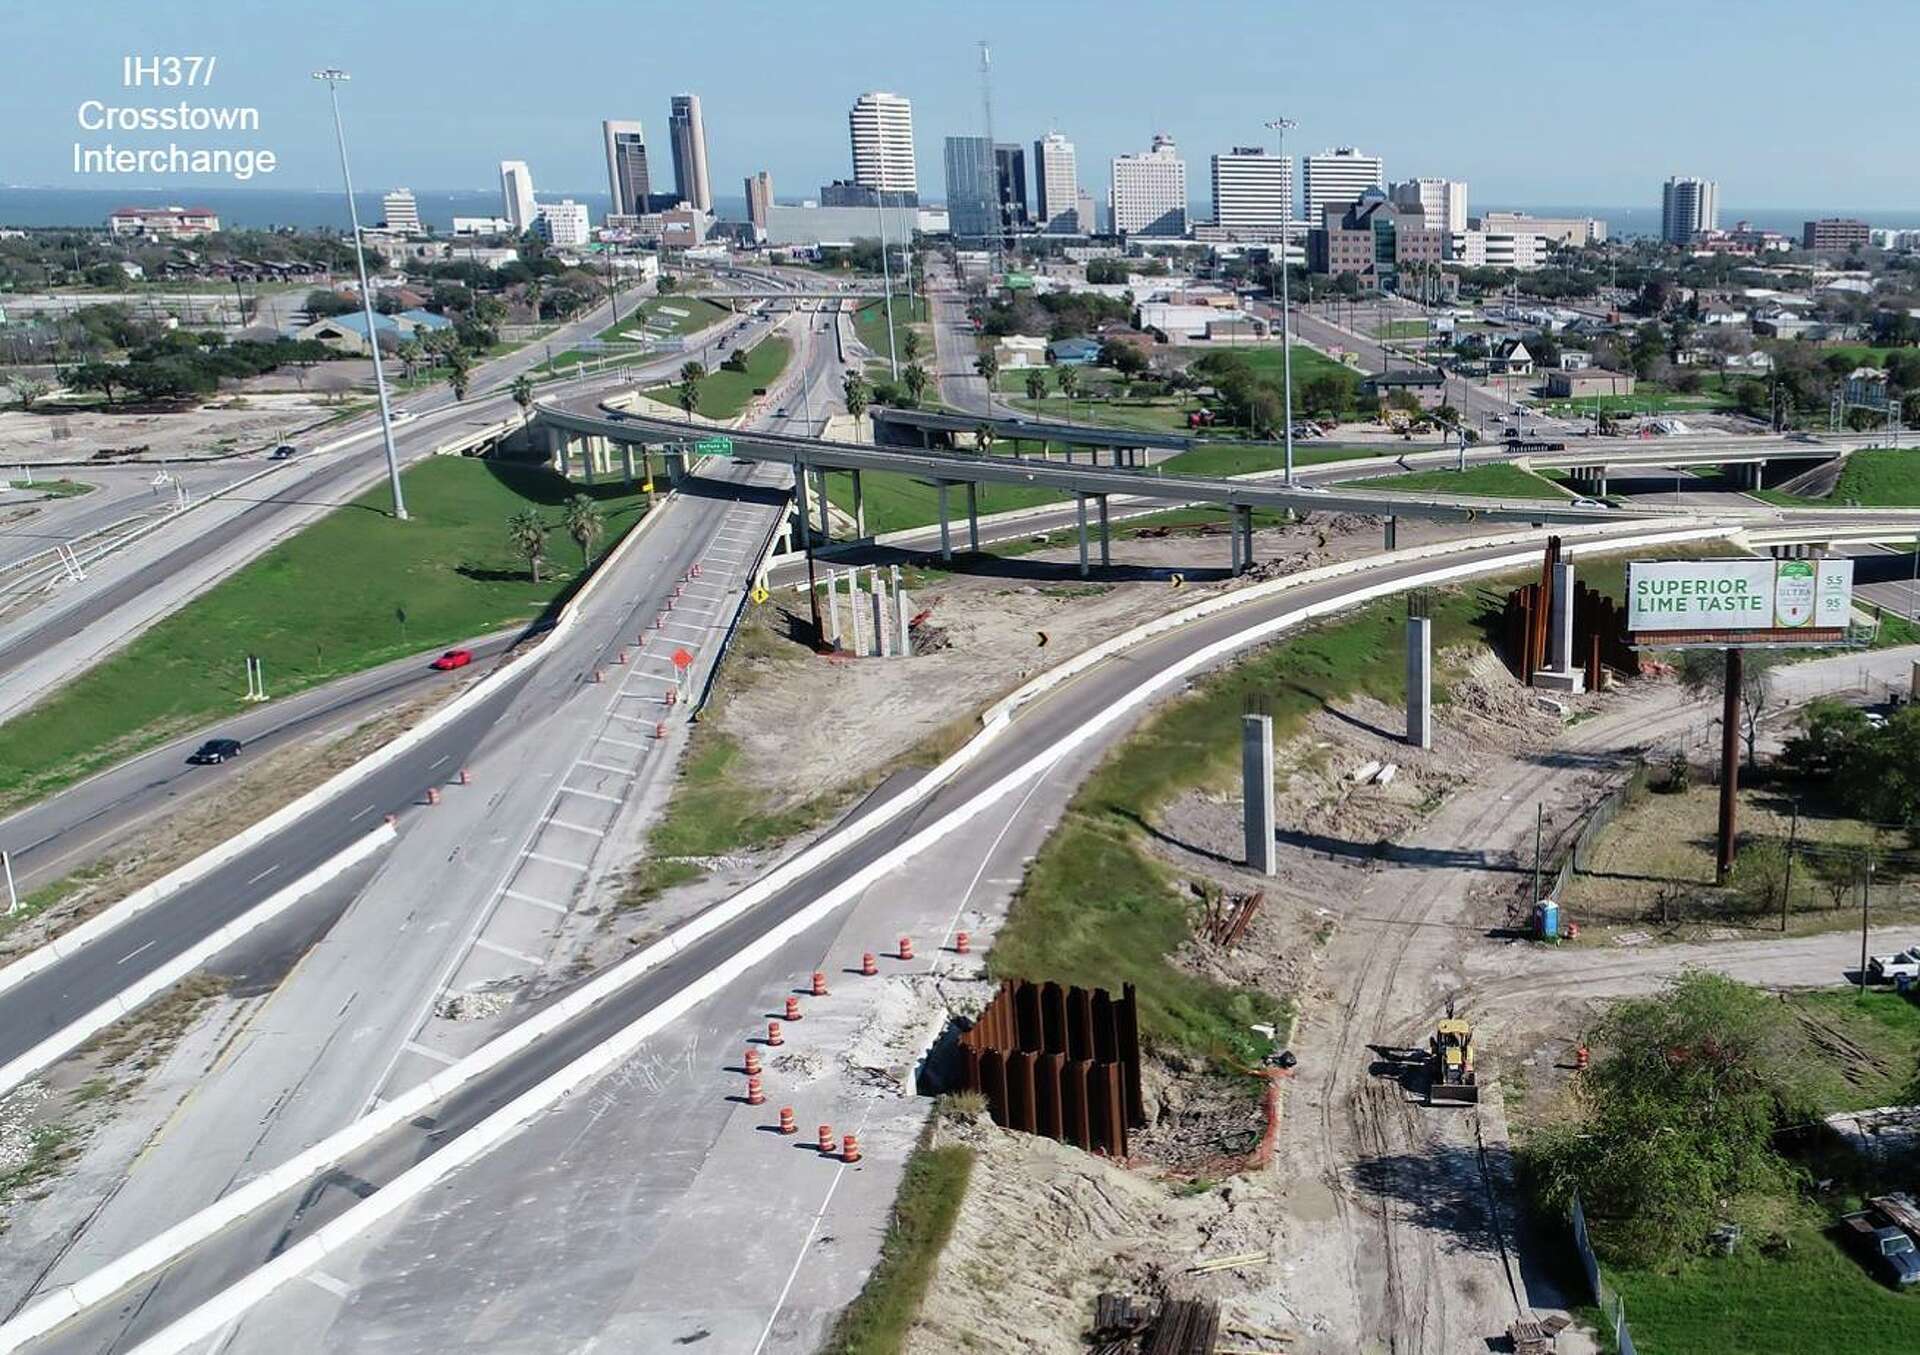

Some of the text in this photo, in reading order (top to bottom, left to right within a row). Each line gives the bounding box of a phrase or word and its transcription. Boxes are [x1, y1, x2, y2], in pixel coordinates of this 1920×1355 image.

[1637, 579, 1748, 595] SUPERIOR
[1637, 596, 1763, 612] LIME TASTE
